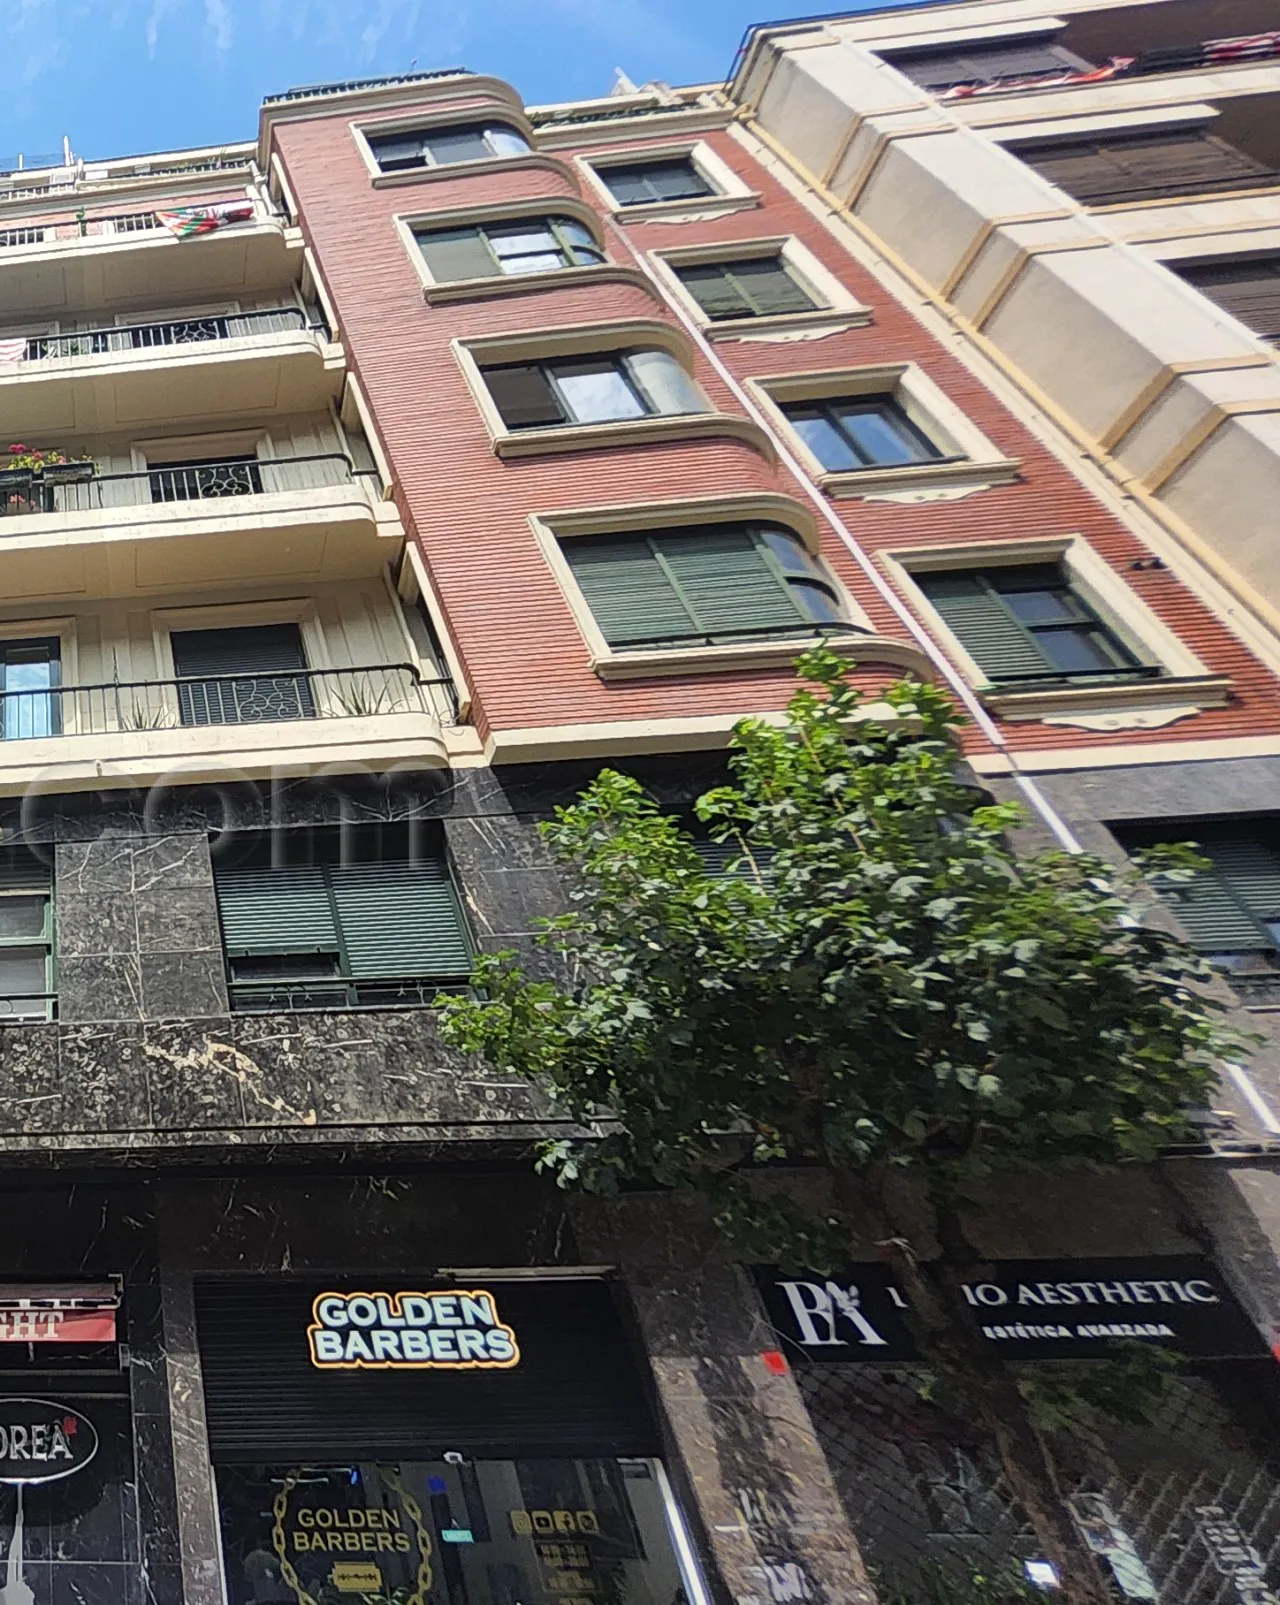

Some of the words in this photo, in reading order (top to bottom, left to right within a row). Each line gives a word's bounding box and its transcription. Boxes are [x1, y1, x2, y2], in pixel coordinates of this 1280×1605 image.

[1018, 1279, 1220, 1306] AESTHETIC
[319, 1296, 496, 1328] GOLDEN
[314, 1328, 515, 1361] BARBERS
[297, 1508, 401, 1529] GOLDEN
[292, 1531, 412, 1552] BARBERS
